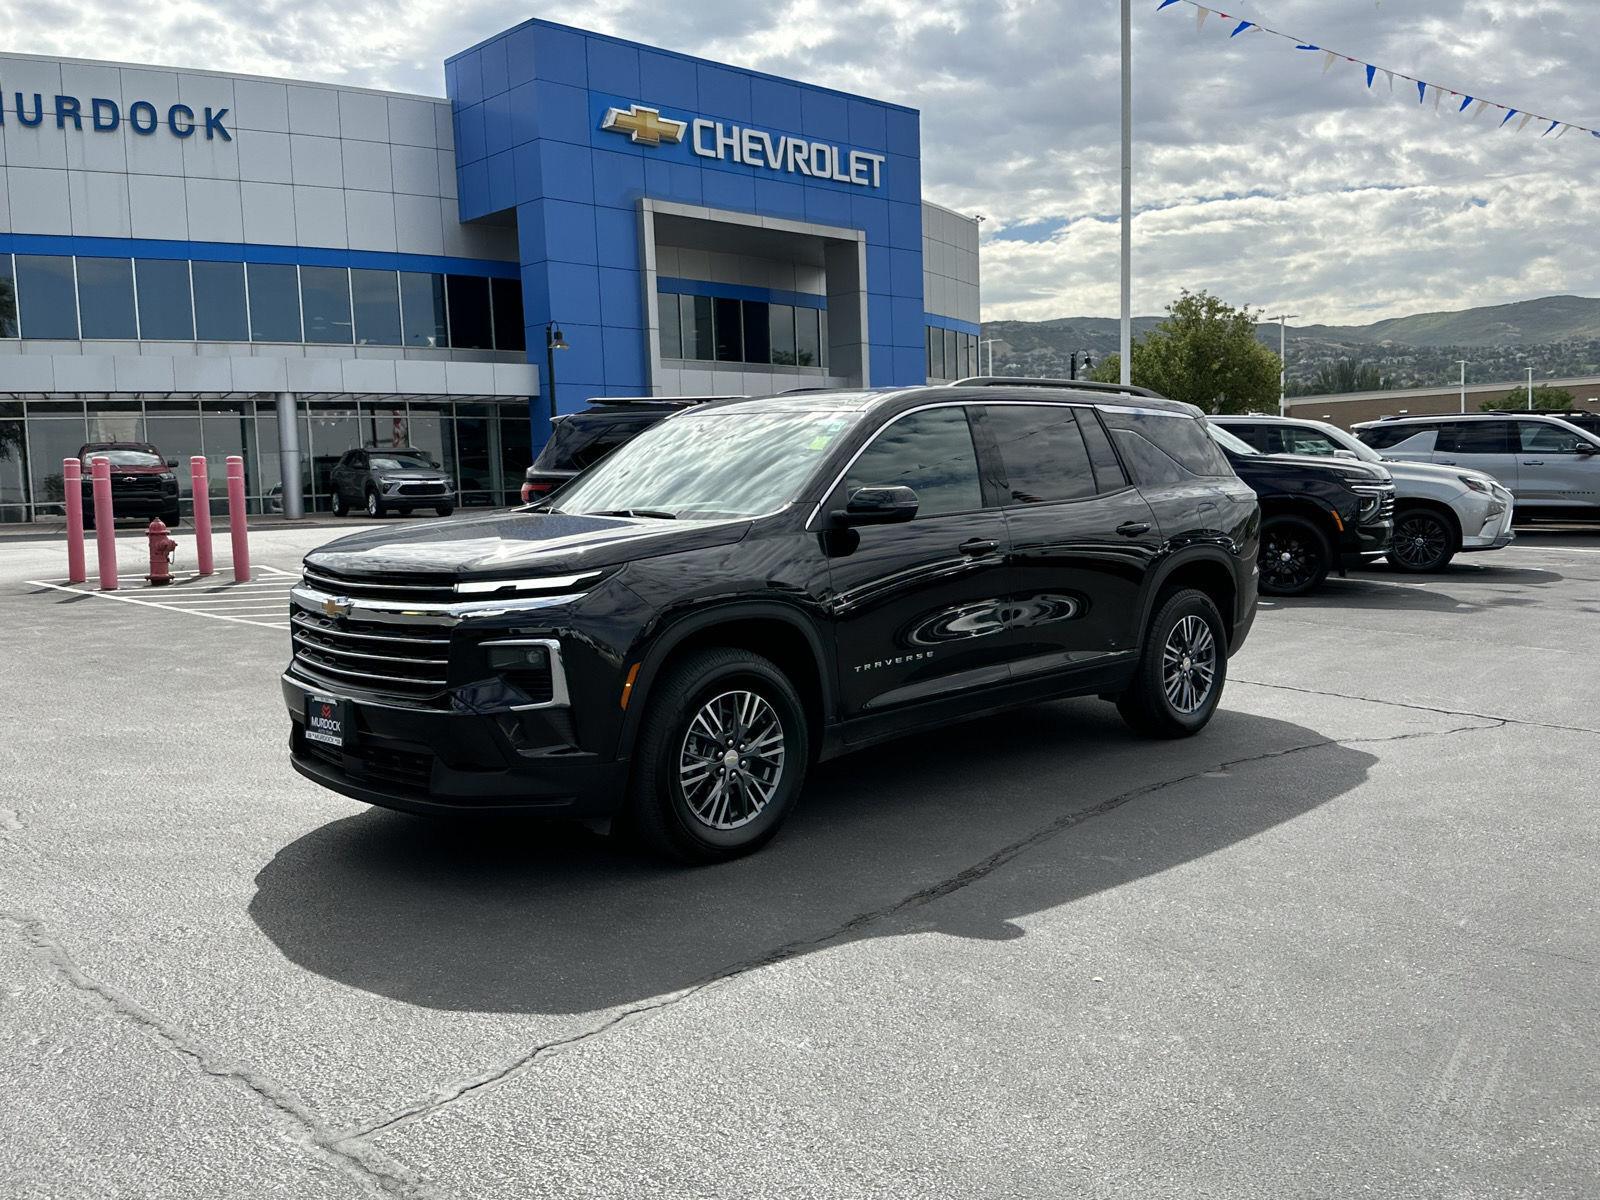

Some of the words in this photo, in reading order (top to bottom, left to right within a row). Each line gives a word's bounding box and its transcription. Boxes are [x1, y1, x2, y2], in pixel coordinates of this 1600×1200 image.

[0, 91, 232, 141] URDOCK
[692, 118, 885, 187] CHEVROLET
[854, 651, 934, 672] TRAVERSE
[311, 716, 341, 731] MURDOCK
